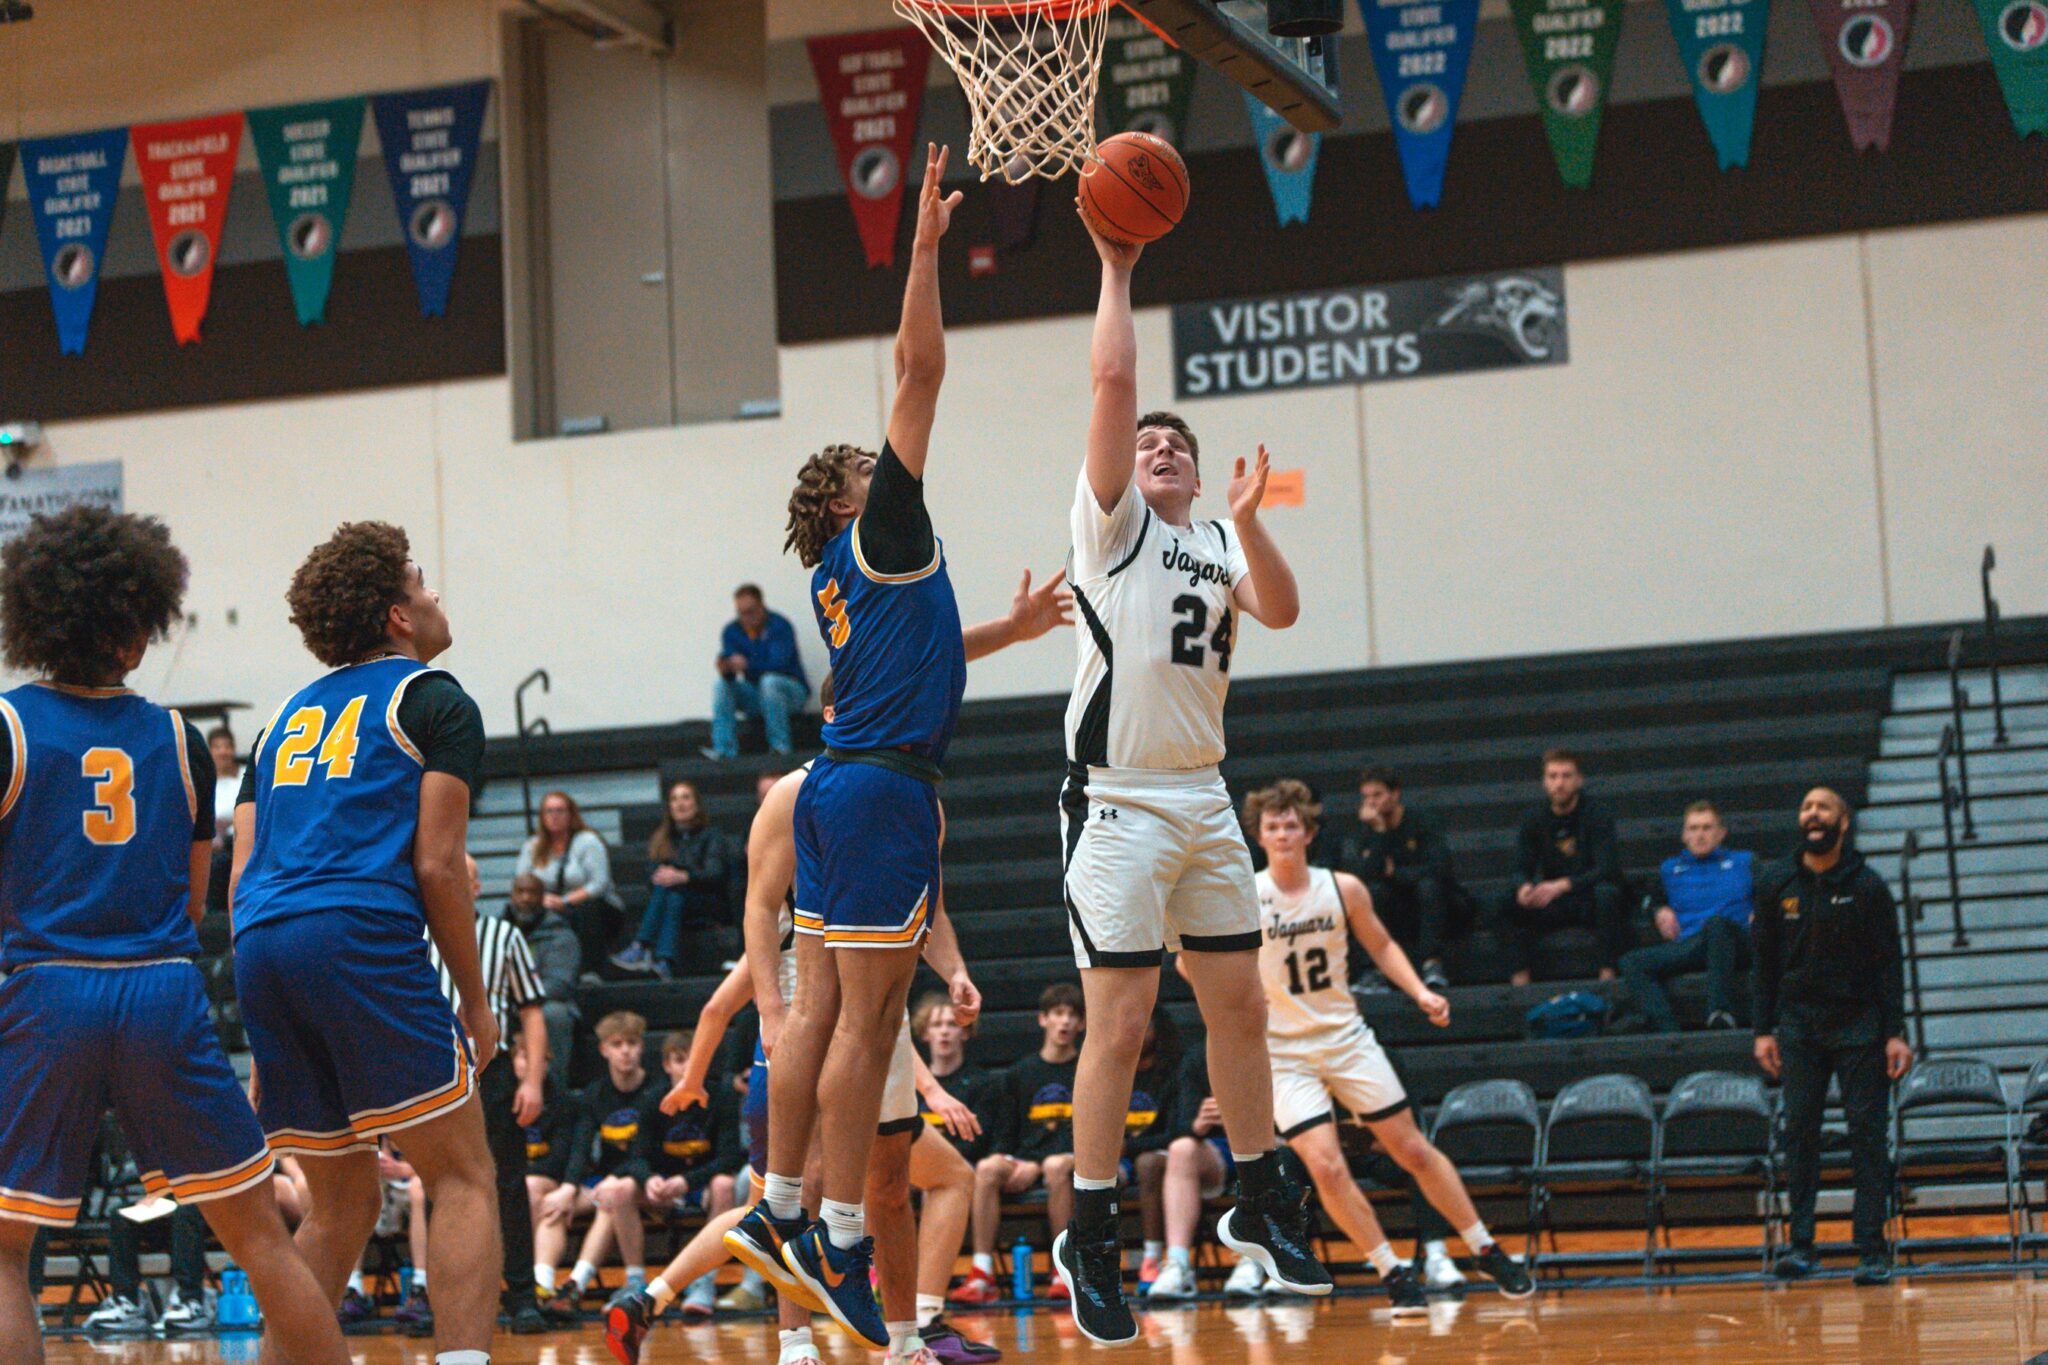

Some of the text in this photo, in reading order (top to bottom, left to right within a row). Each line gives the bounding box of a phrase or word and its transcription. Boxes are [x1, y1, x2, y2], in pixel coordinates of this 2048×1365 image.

[1545, 34, 1593, 59] 2022
[1695, 11, 1744, 38] 2022
[1398, 52, 1447, 77] 2022
[1211, 290, 1389, 344] VISITOR
[1185, 331, 1422, 394] STUDENTS
[817, 577, 851, 649] 5
[1171, 592, 1232, 673] 24
[271, 694, 368, 791] 24
[81, 746, 136, 844] 3
[1268, 913, 1335, 947] Jaguars
[1285, 947, 1332, 995] 12
